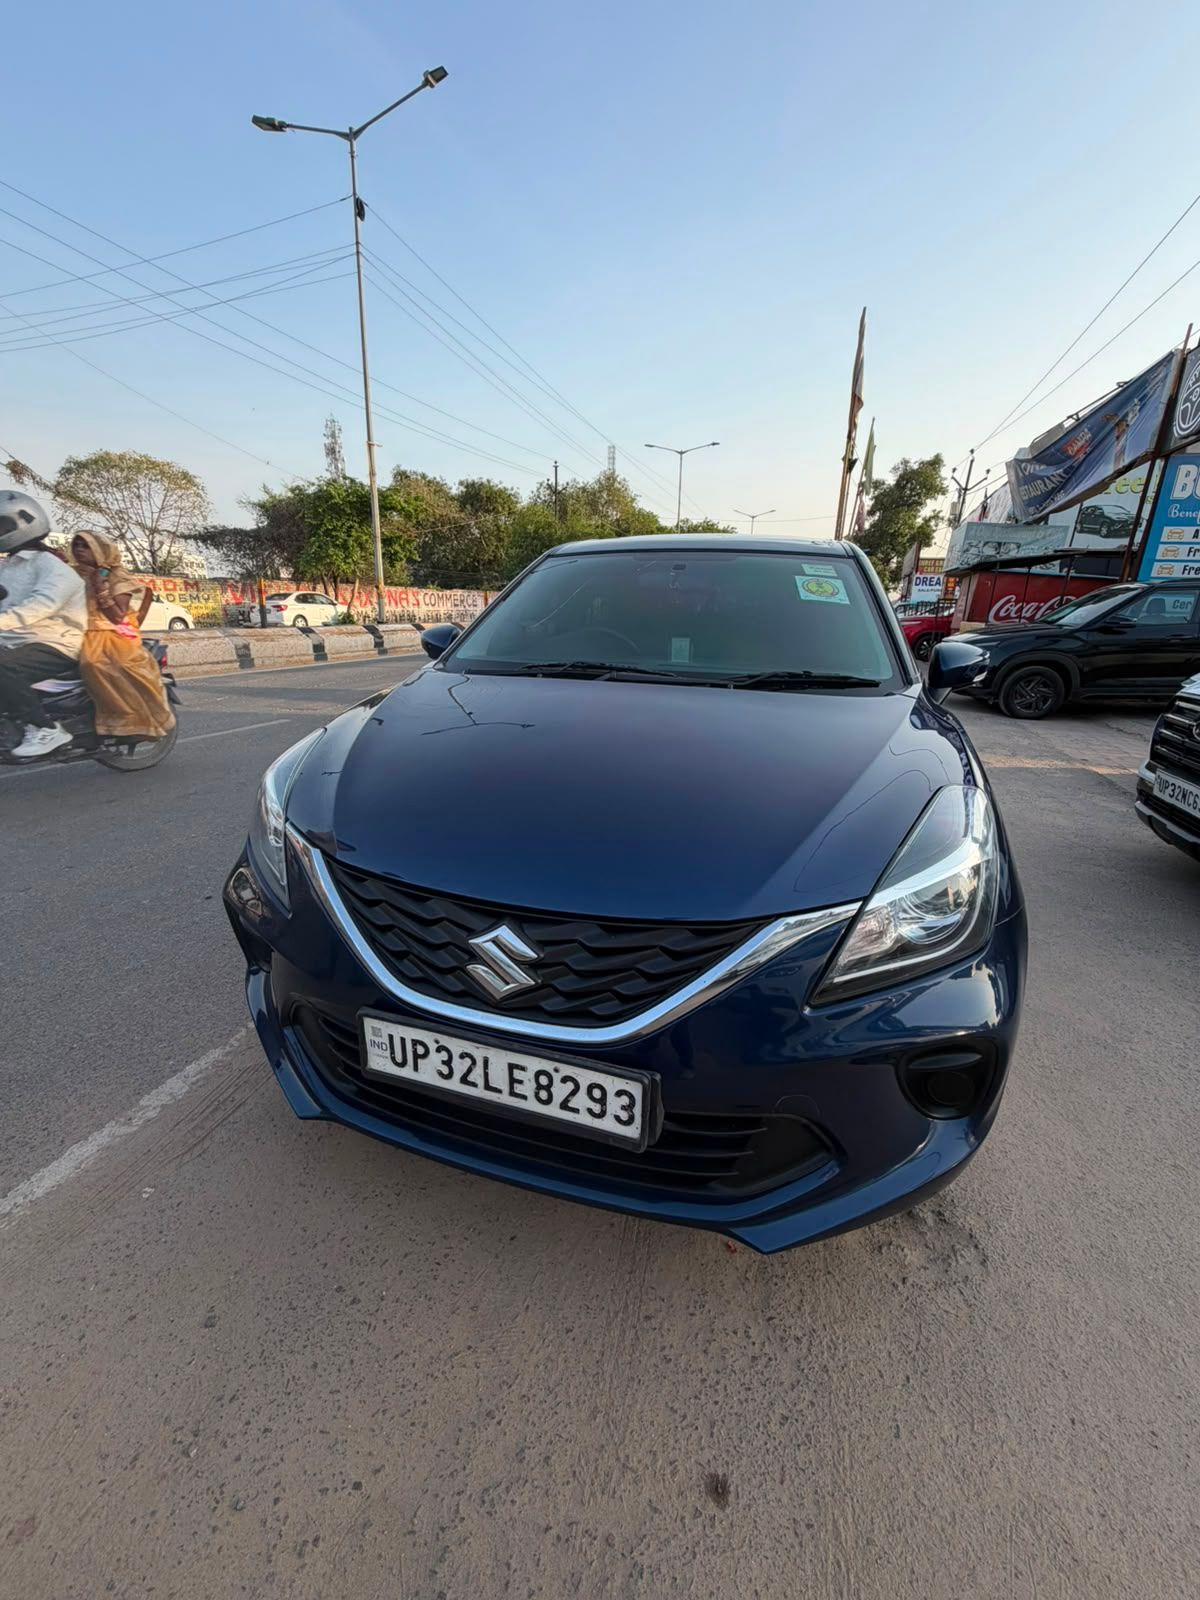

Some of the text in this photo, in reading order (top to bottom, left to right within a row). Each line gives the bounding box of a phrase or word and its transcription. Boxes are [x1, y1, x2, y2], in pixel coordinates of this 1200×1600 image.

[1104, 478, 1144, 495] ree
[1170, 464, 1200, 500] B
[1168, 504, 1200, 523] Bene
[1187, 547, 1200, 558] Fr
[423, 592, 478, 608] COMMERCE
[1158, 775, 1200, 812] UP32NC6
[369, 1038, 388, 1052] IND
[387, 1033, 636, 1126] UP32LE8293
